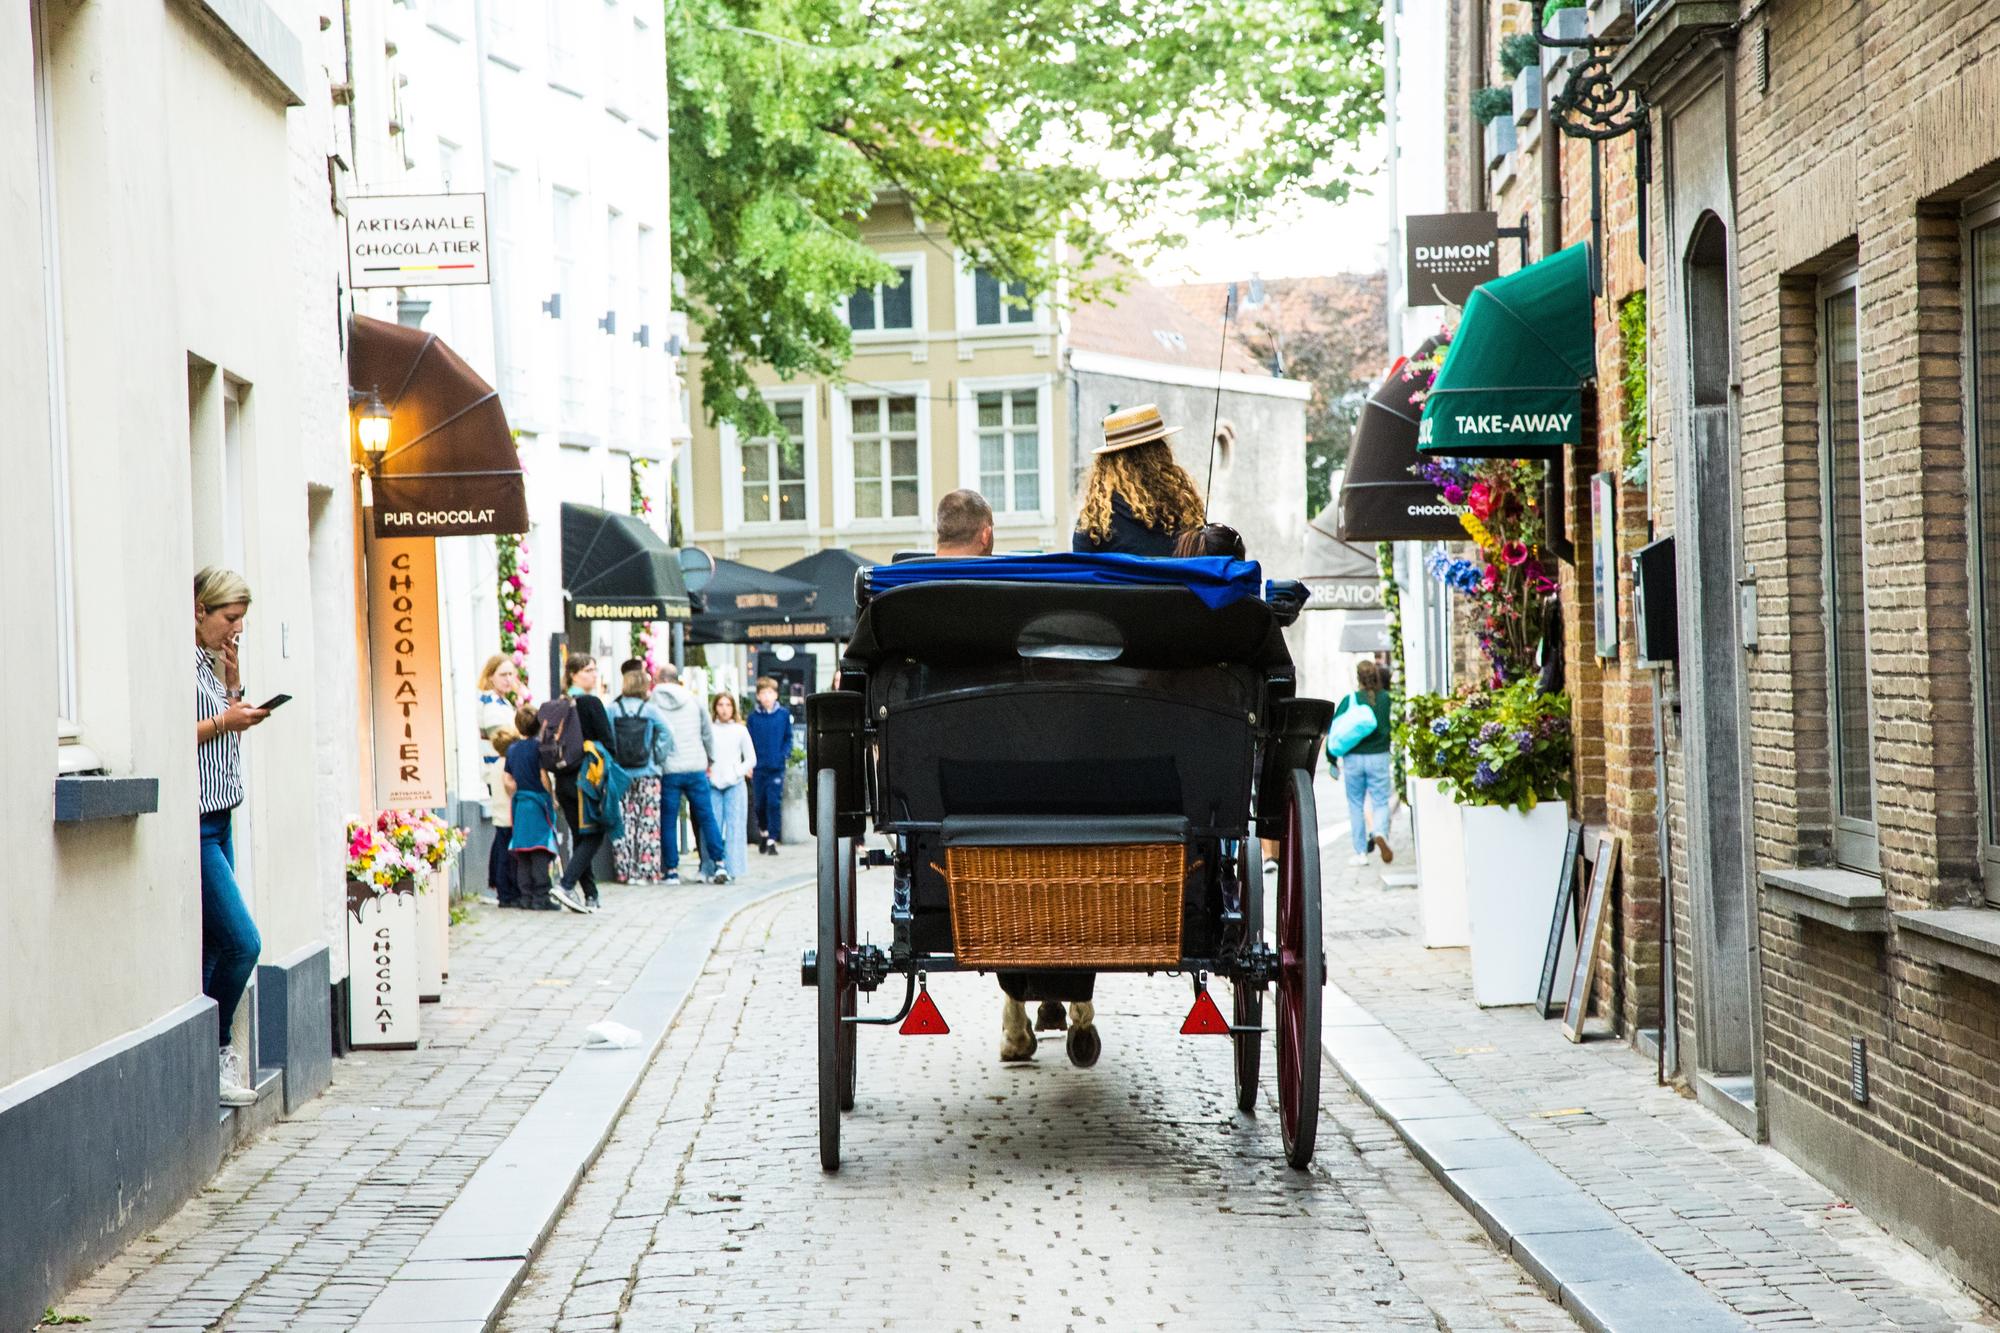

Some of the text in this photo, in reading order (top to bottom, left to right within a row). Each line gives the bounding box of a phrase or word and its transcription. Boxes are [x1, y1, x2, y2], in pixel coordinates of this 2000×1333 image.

[356, 216, 475, 232] ARTISANALE
[355, 240, 480, 256] CHOCOLATIER
[1415, 244, 1490, 260] DUMON
[1455, 414, 1573, 434] TAKE-AWAY
[384, 509, 496, 525] PUR CHOCOLAT
[575, 603, 658, 618] Restaurant
[389, 553, 420, 783] CHOCOLATIER
[373, 928, 393, 1033] CHOCOLAT
